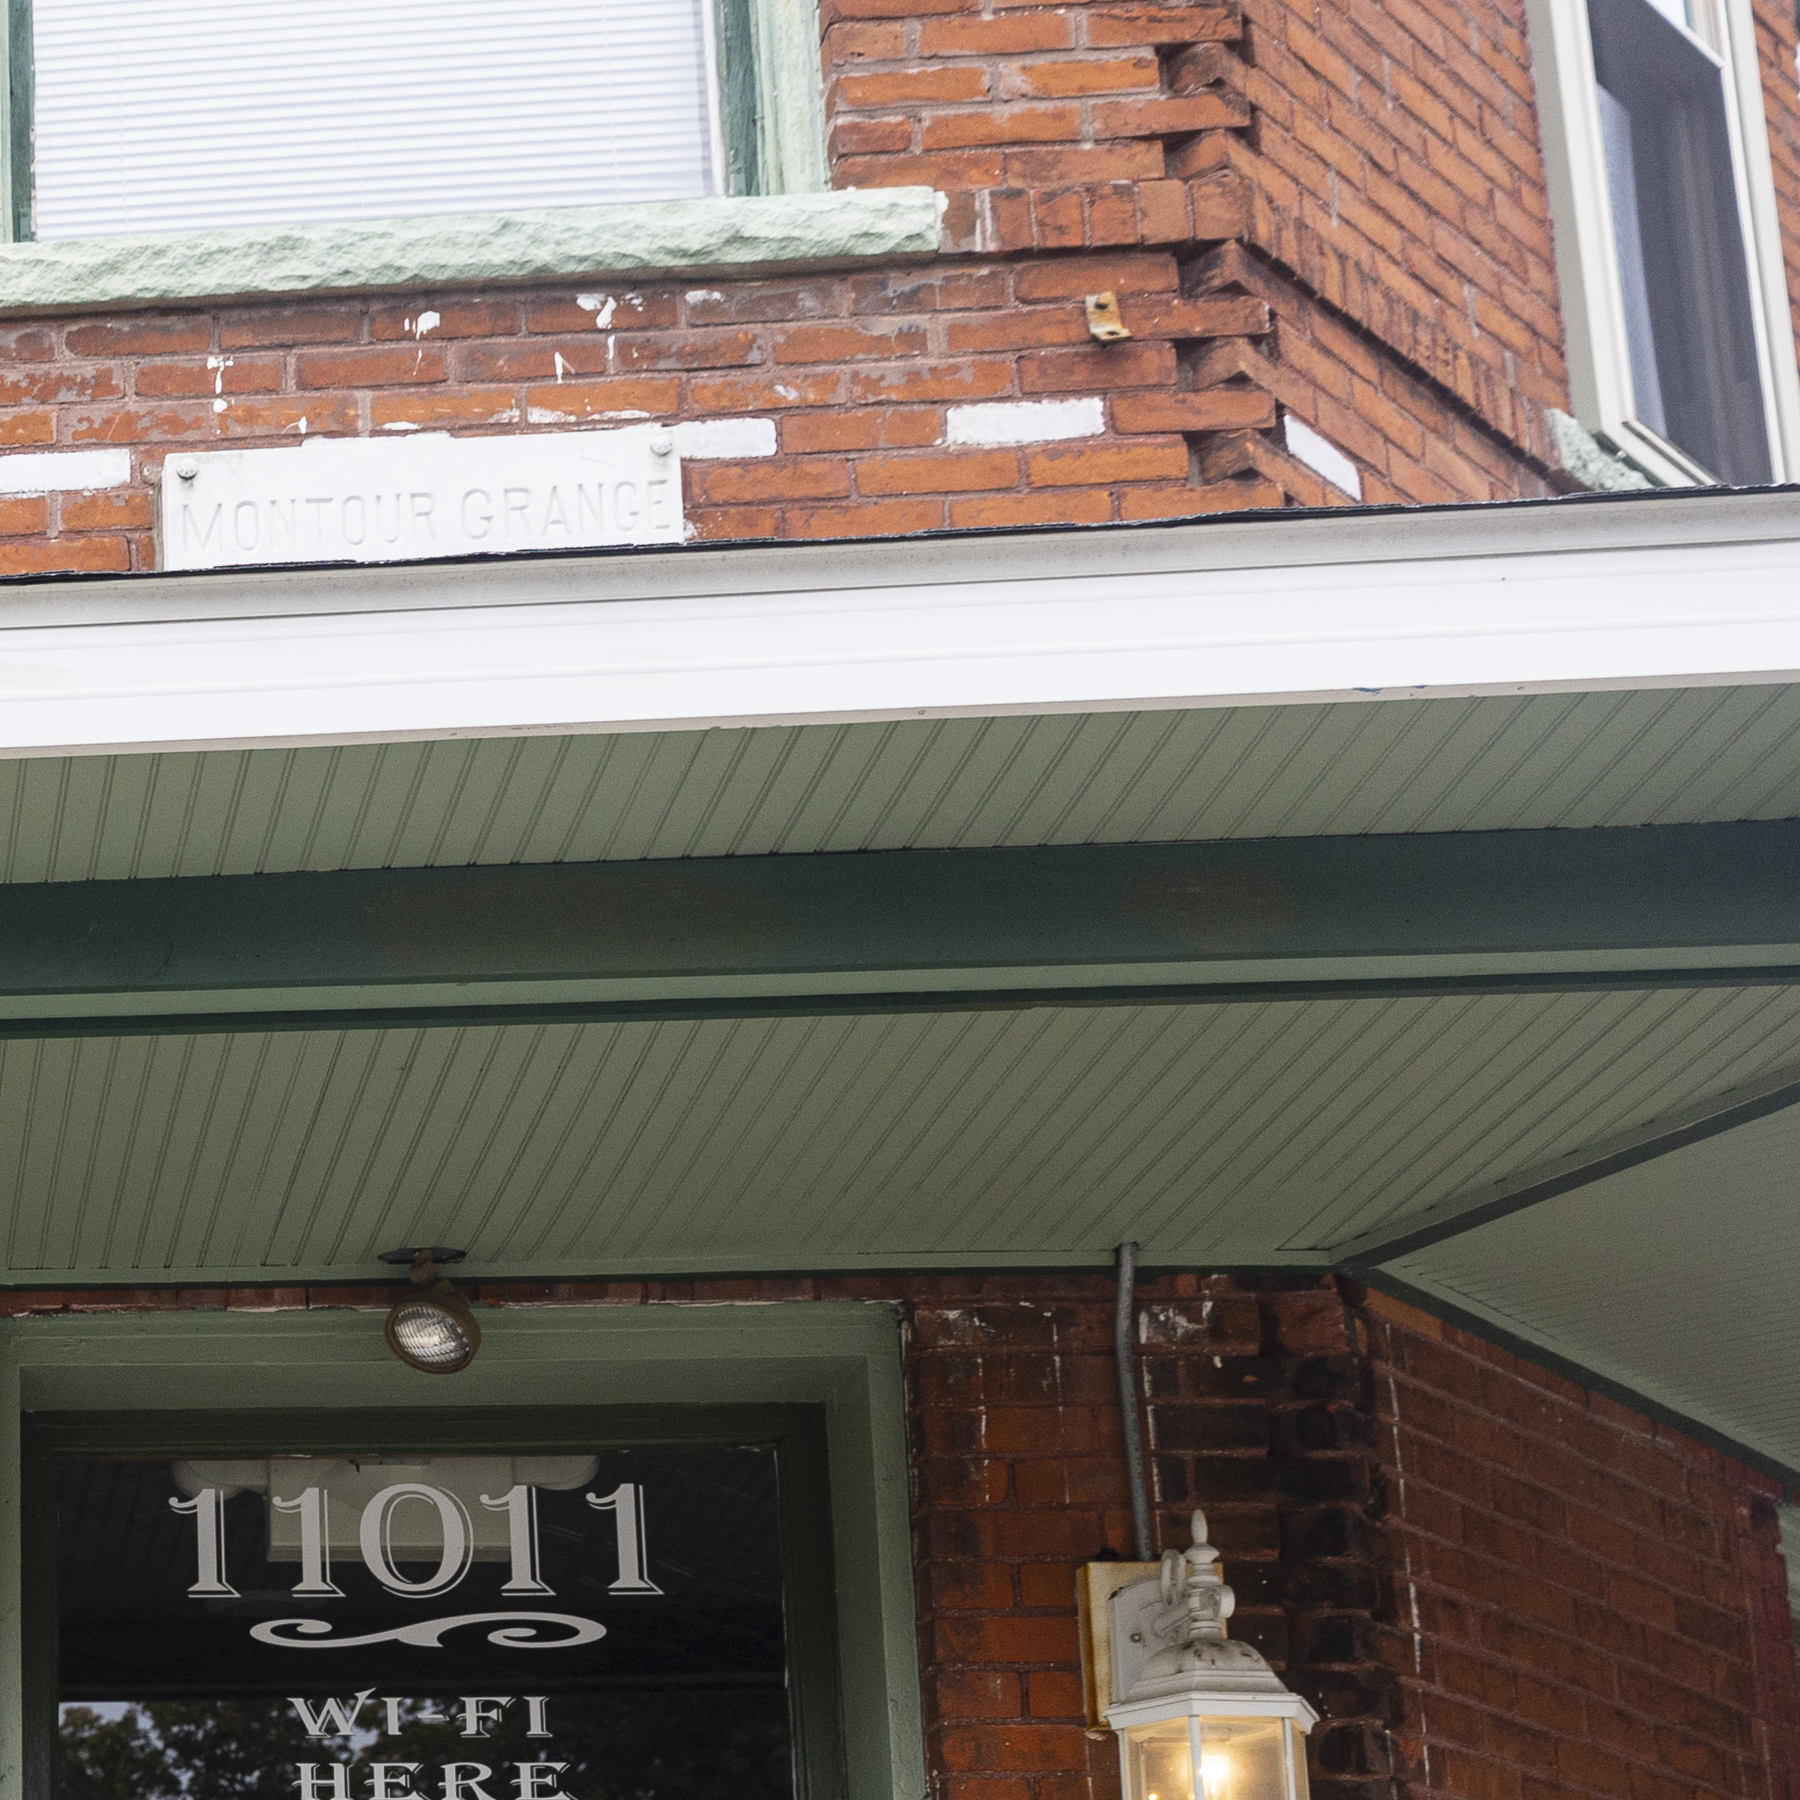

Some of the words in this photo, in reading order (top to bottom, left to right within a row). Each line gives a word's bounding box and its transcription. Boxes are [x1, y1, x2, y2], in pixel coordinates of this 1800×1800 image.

[179, 491, 438, 556] MONTOUR
[460, 478, 672, 541] GRANGE
[167, 1481, 665, 1599] 11011
[287, 1686, 554, 1740] WI-FI
